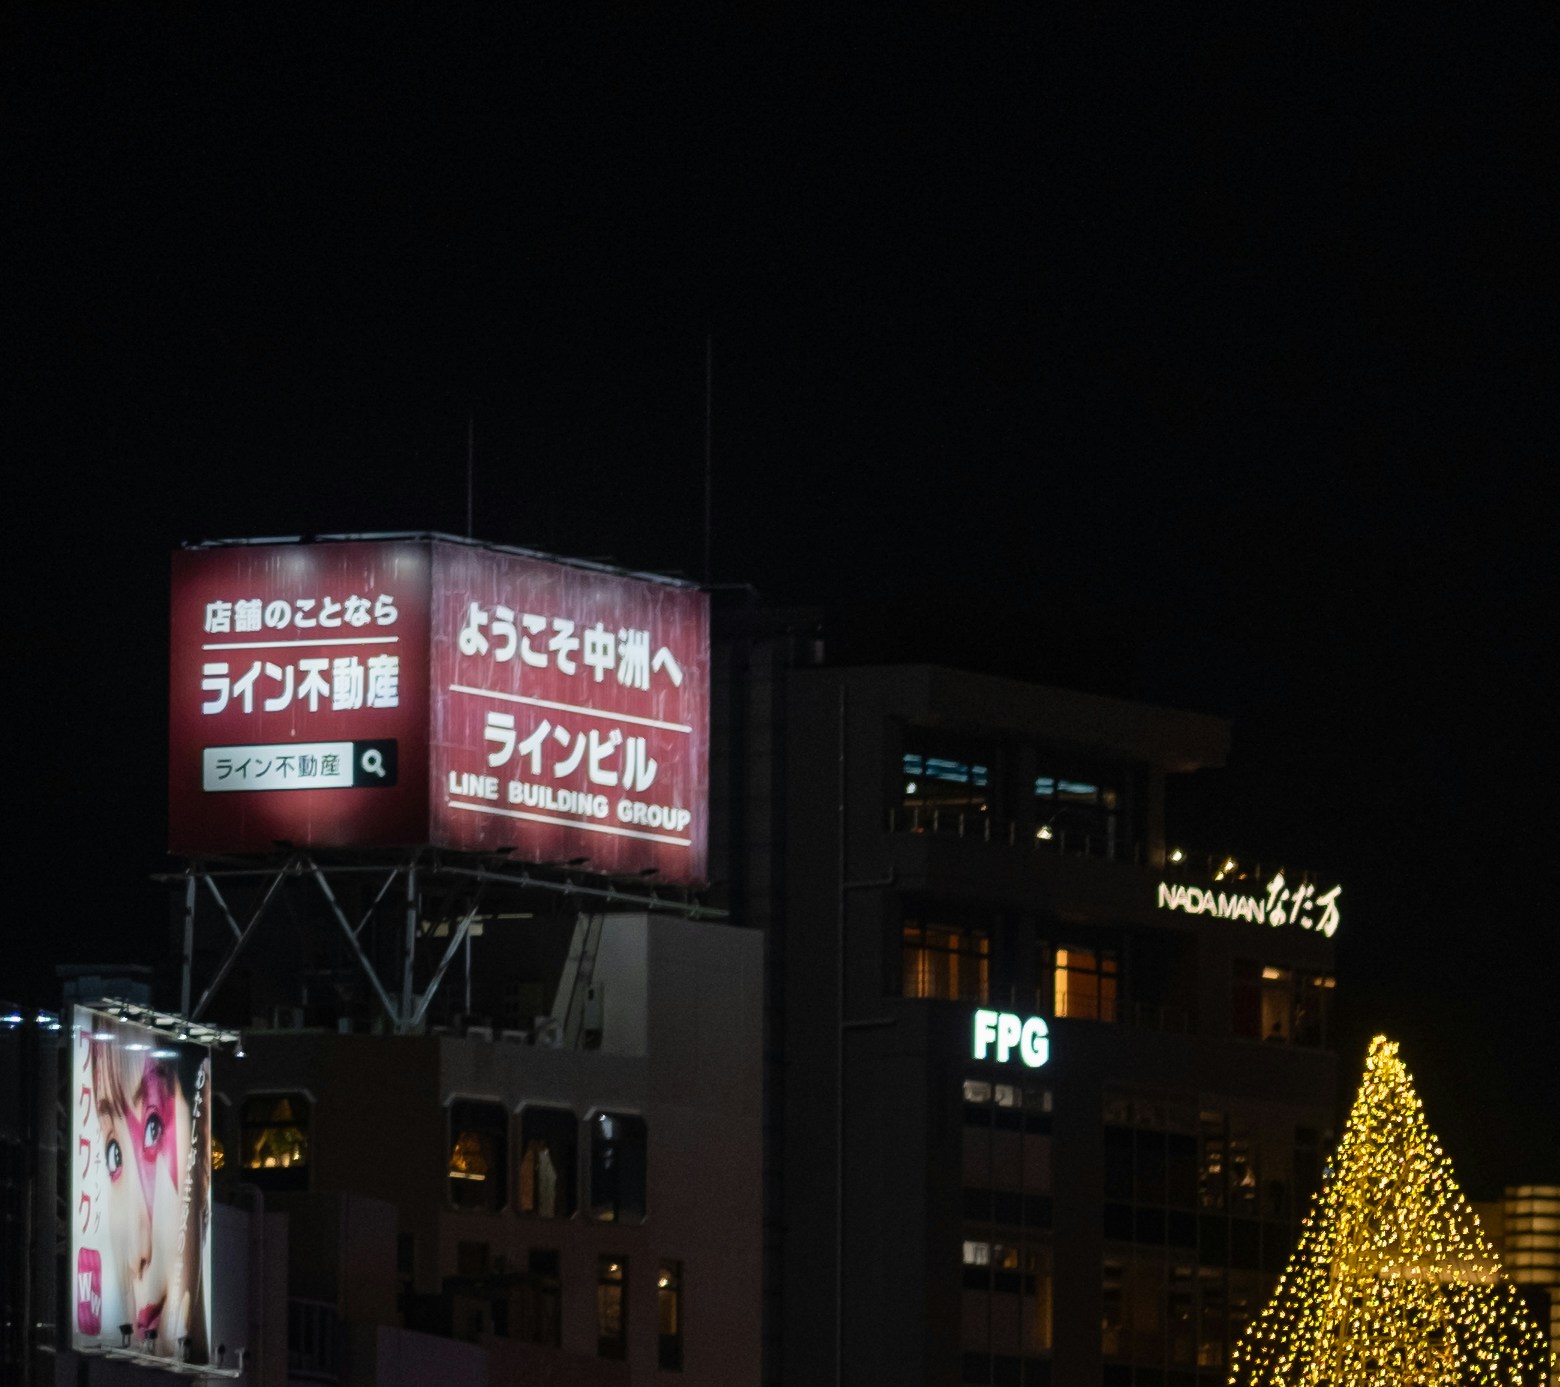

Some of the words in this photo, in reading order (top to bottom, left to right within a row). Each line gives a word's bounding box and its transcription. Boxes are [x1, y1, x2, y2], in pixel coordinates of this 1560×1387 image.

[205, 594, 398, 633] 店舗のことなら
[459, 602, 683, 691] ようこそ中洲へ
[201, 655, 399, 714] ライン不動産
[214, 753, 341, 781] ライン不動産
[485, 713, 657, 793] ラインビル
[449, 772, 498, 800] LINE
[508, 781, 608, 819] BUILDING
[618, 800, 691, 832] GROUP
[973, 1009, 1049, 1068] FPG
